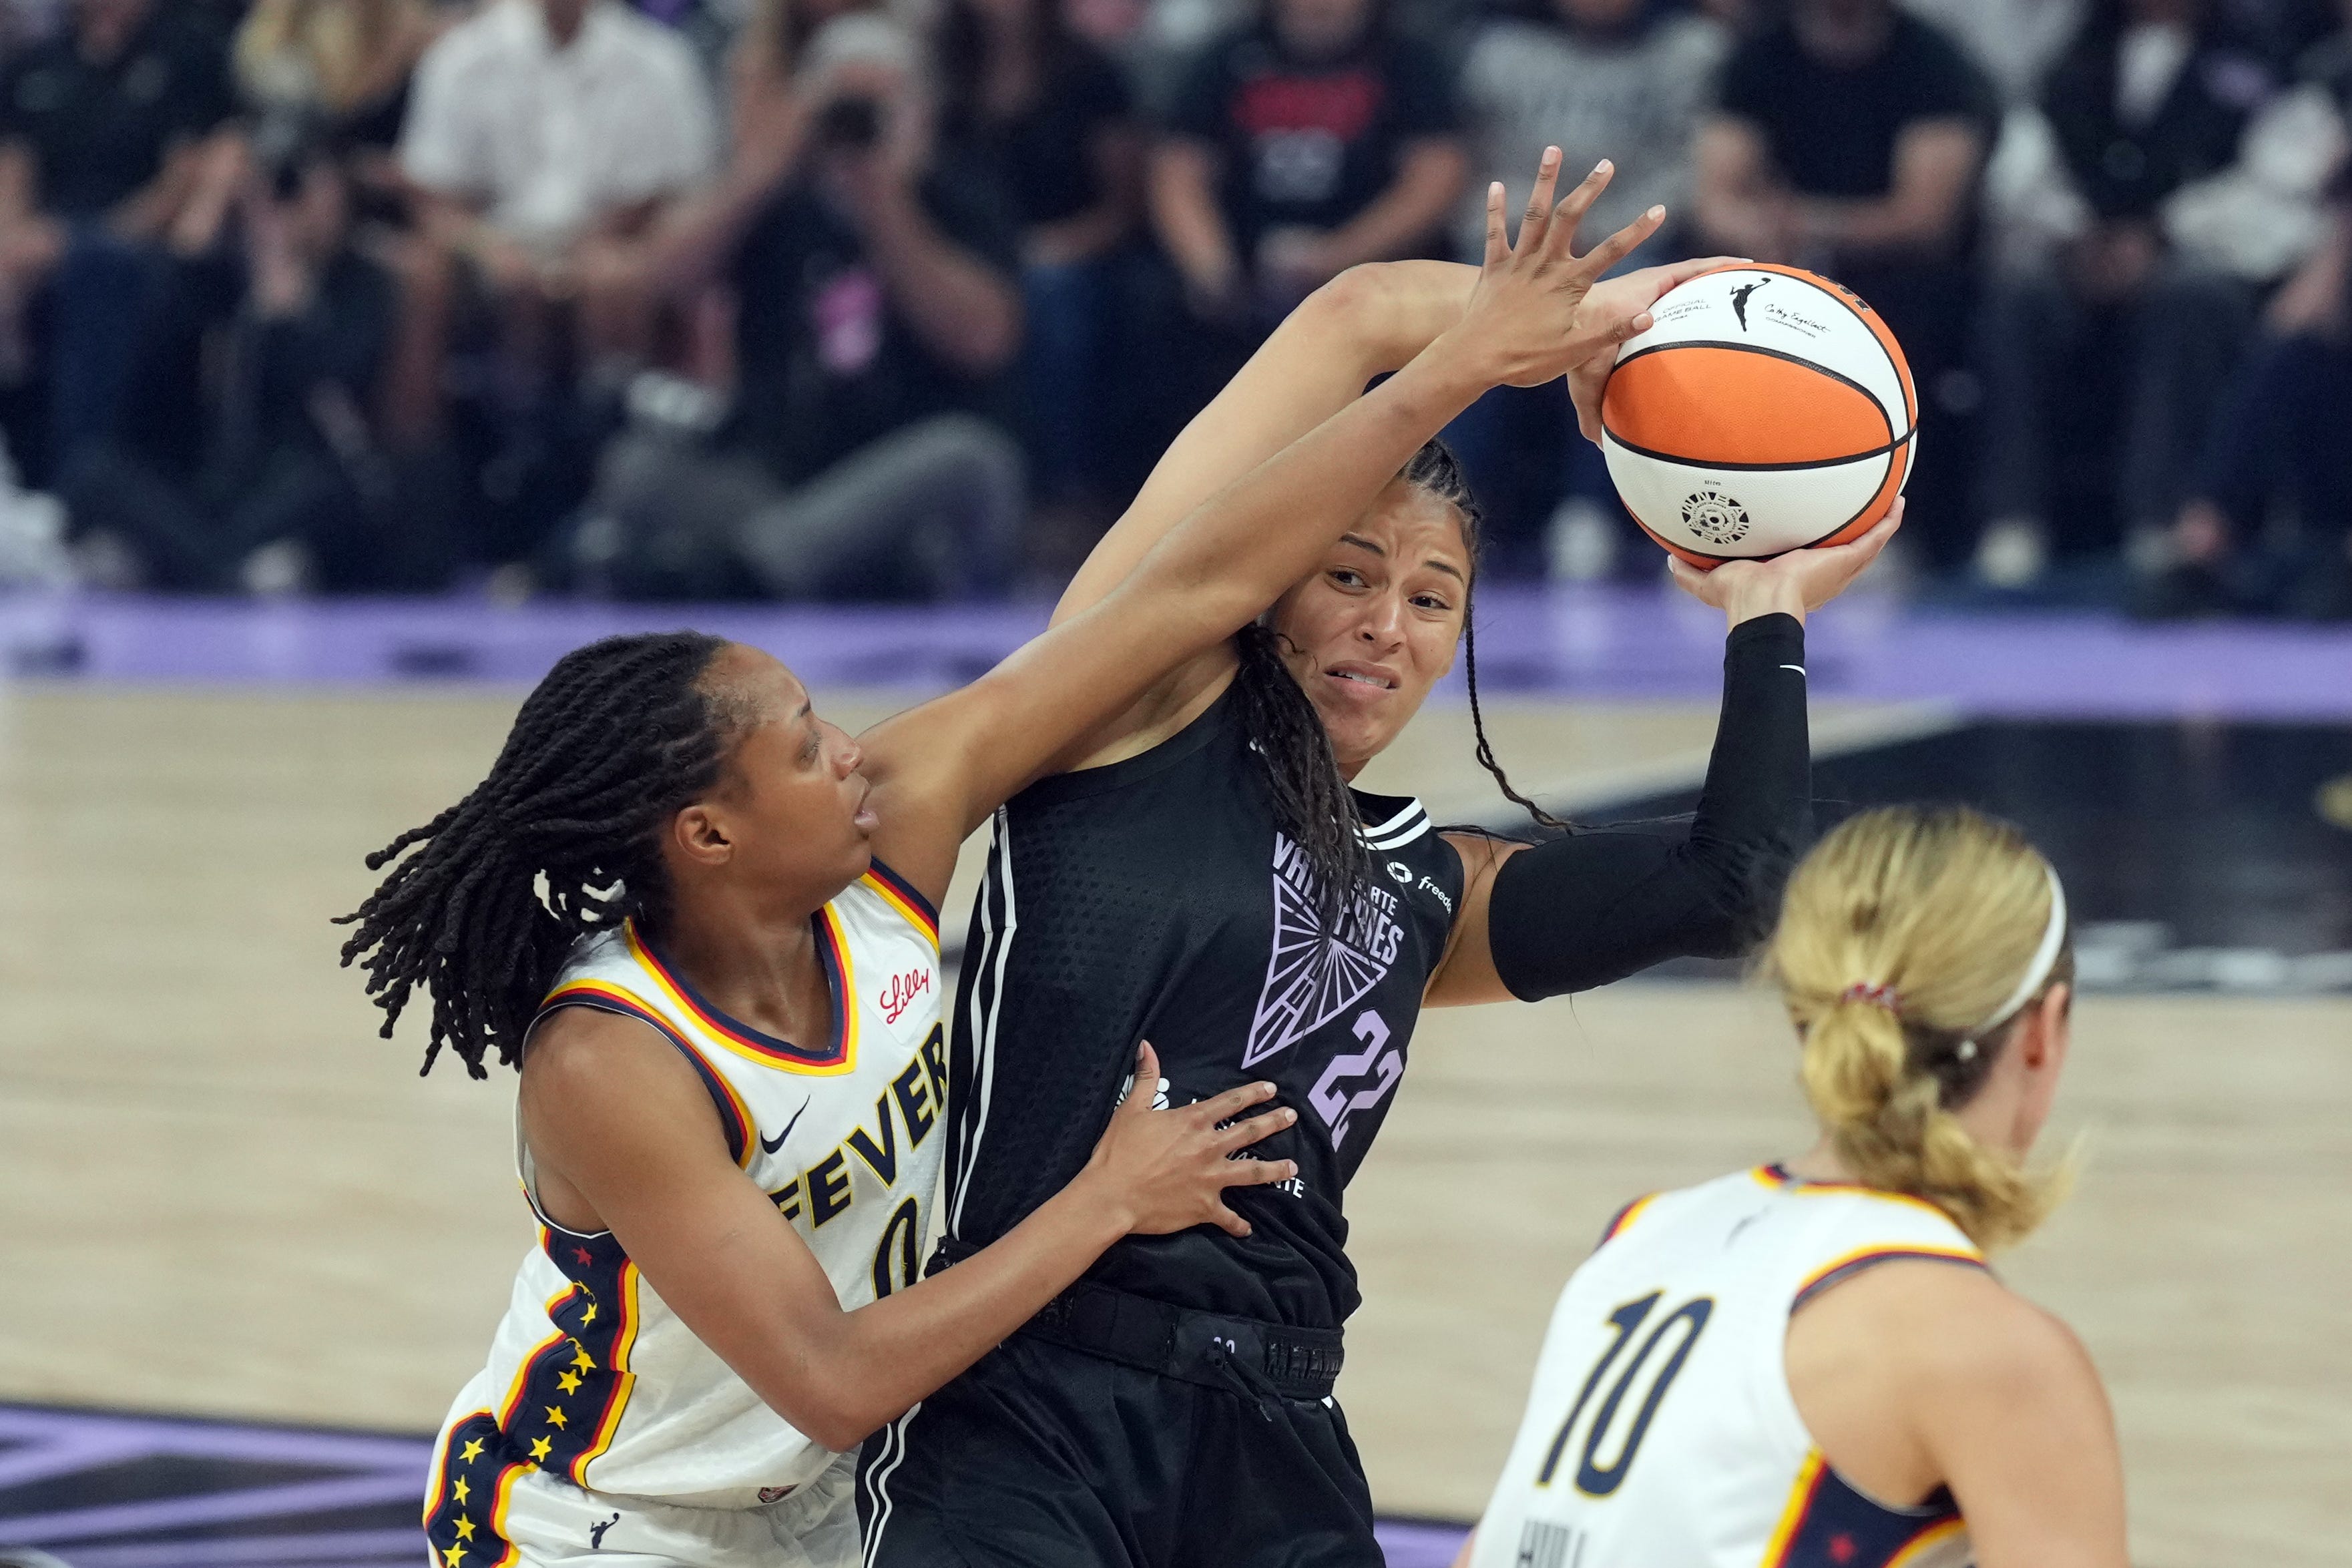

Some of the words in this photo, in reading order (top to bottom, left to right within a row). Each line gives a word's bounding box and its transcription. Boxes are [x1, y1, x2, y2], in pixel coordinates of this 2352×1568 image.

[1684, 304, 1712, 313] BALL
[880, 968, 929, 1025] Lilly
[1308, 1008, 1403, 1153] 22
[1536, 1289, 1716, 1501] 10
